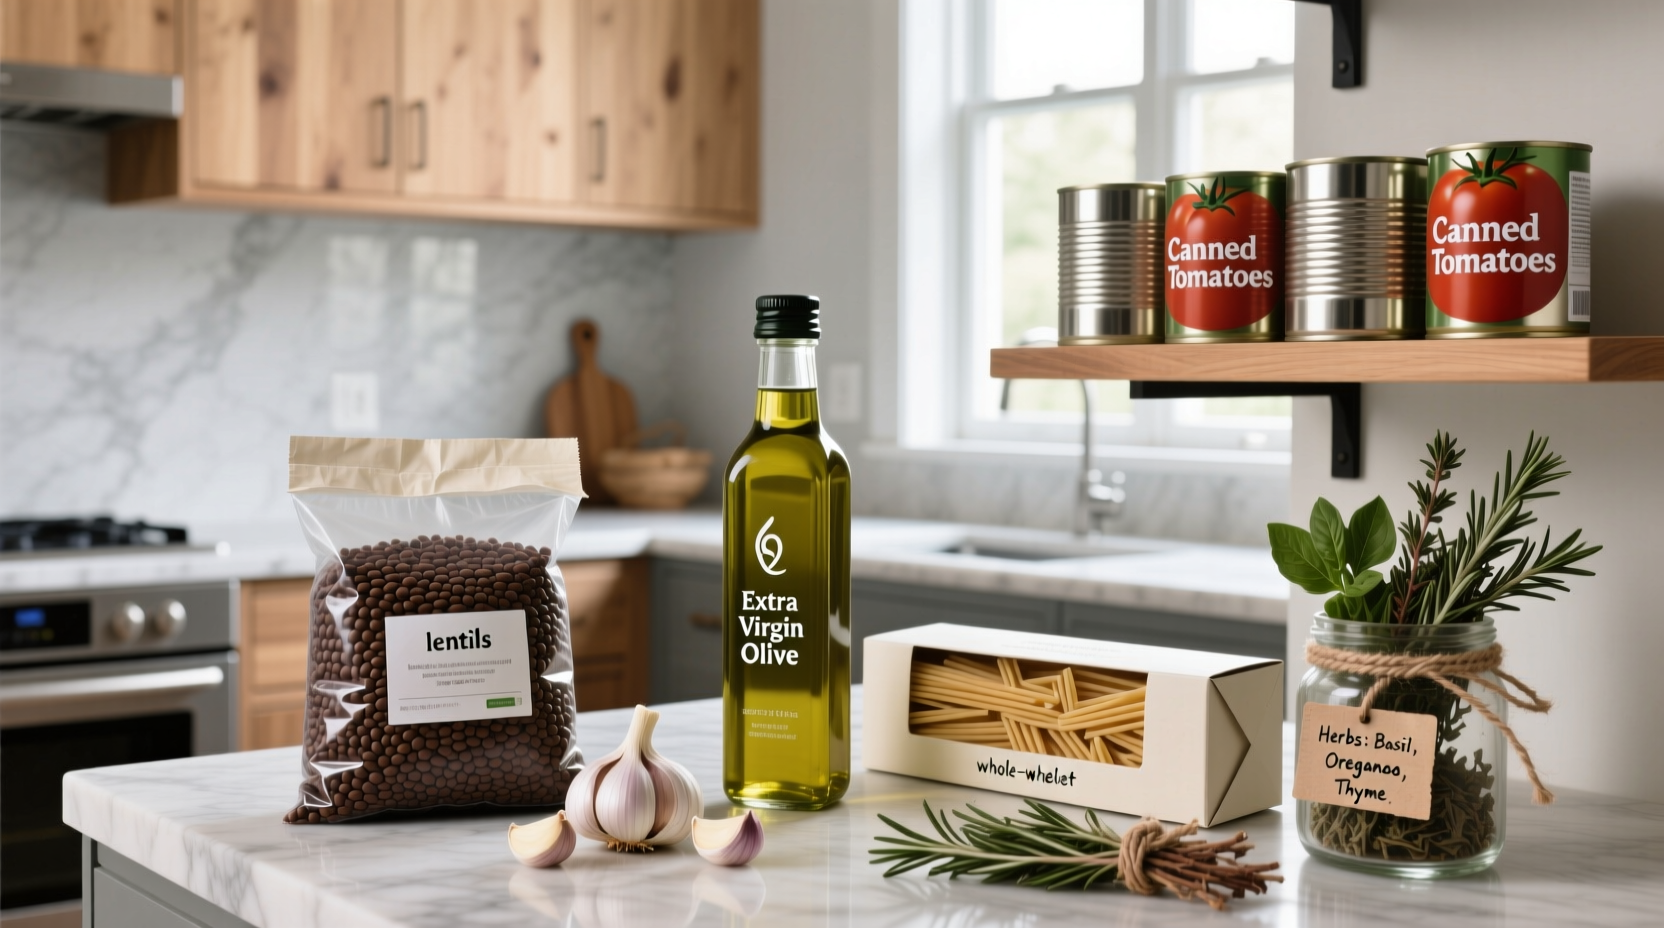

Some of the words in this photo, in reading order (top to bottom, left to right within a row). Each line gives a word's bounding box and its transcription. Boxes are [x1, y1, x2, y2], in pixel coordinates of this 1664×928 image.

[1432, 212, 1540, 244] Canned
[1168, 234, 1257, 262] Canned
[1431, 248, 1556, 275] Tomatoes
[1167, 264, 1274, 289] Tomatoes
[741, 590, 799, 612] Extra
[426, 627, 492, 652] lentils
[738, 615, 805, 643] Virgin
[740, 642, 799, 666] Olive
[1318, 724, 1368, 747] Herbs:
[1373, 732, 1417, 757] Basil,
